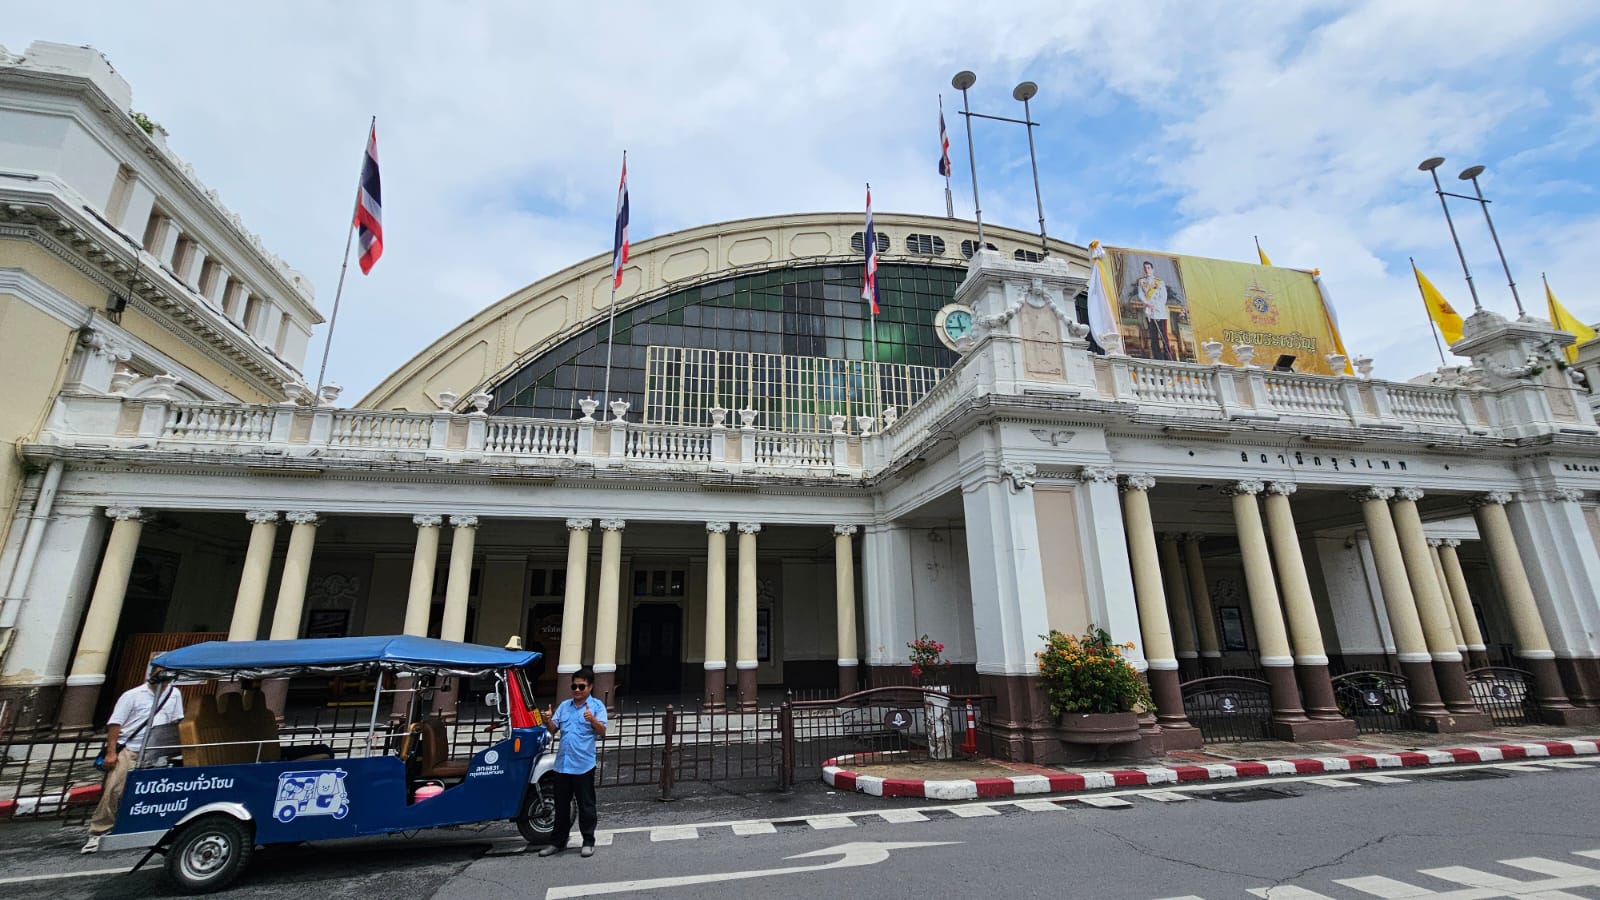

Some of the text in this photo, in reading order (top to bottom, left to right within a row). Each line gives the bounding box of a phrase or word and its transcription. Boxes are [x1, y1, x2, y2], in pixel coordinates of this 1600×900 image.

[1223, 328, 1317, 354] ทรงพระเจริญ
[134, 773, 234, 795] ไปได้ครบทั่วโซน
[129, 797, 189, 817] เรียกมูฟมี
